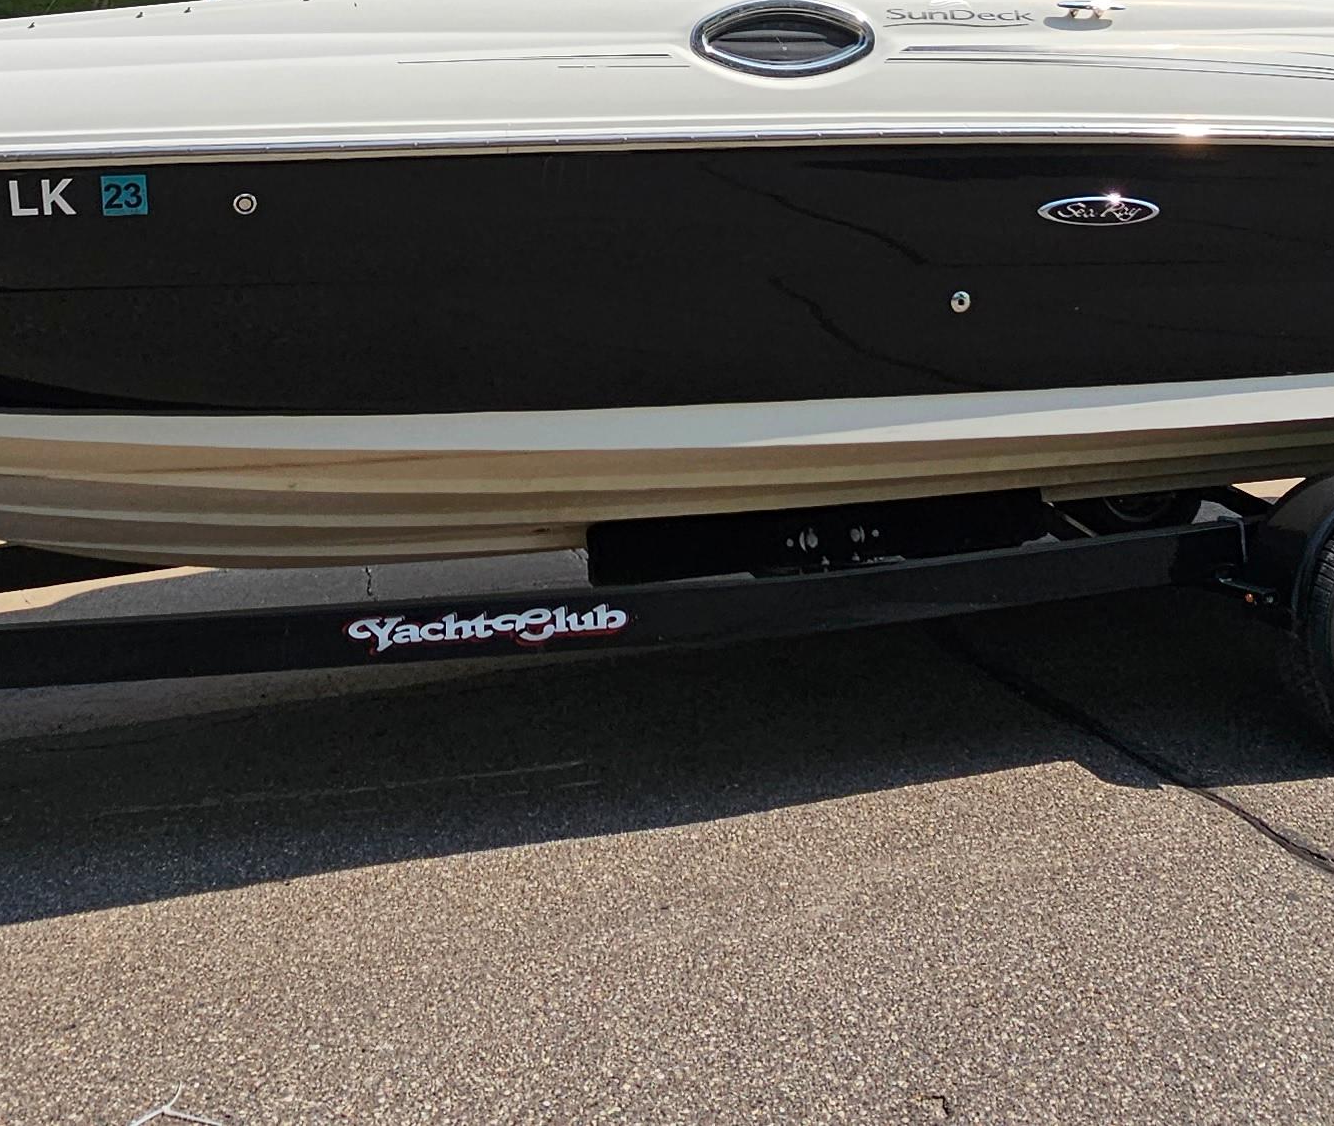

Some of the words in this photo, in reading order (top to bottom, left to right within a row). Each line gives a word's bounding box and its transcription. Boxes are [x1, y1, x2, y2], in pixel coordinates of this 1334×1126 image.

[8, 178, 76, 216] LK
[104, 183, 143, 209] 23
[1057, 202, 1095, 218] Sea
[1100, 200, 1142, 221] Ray
